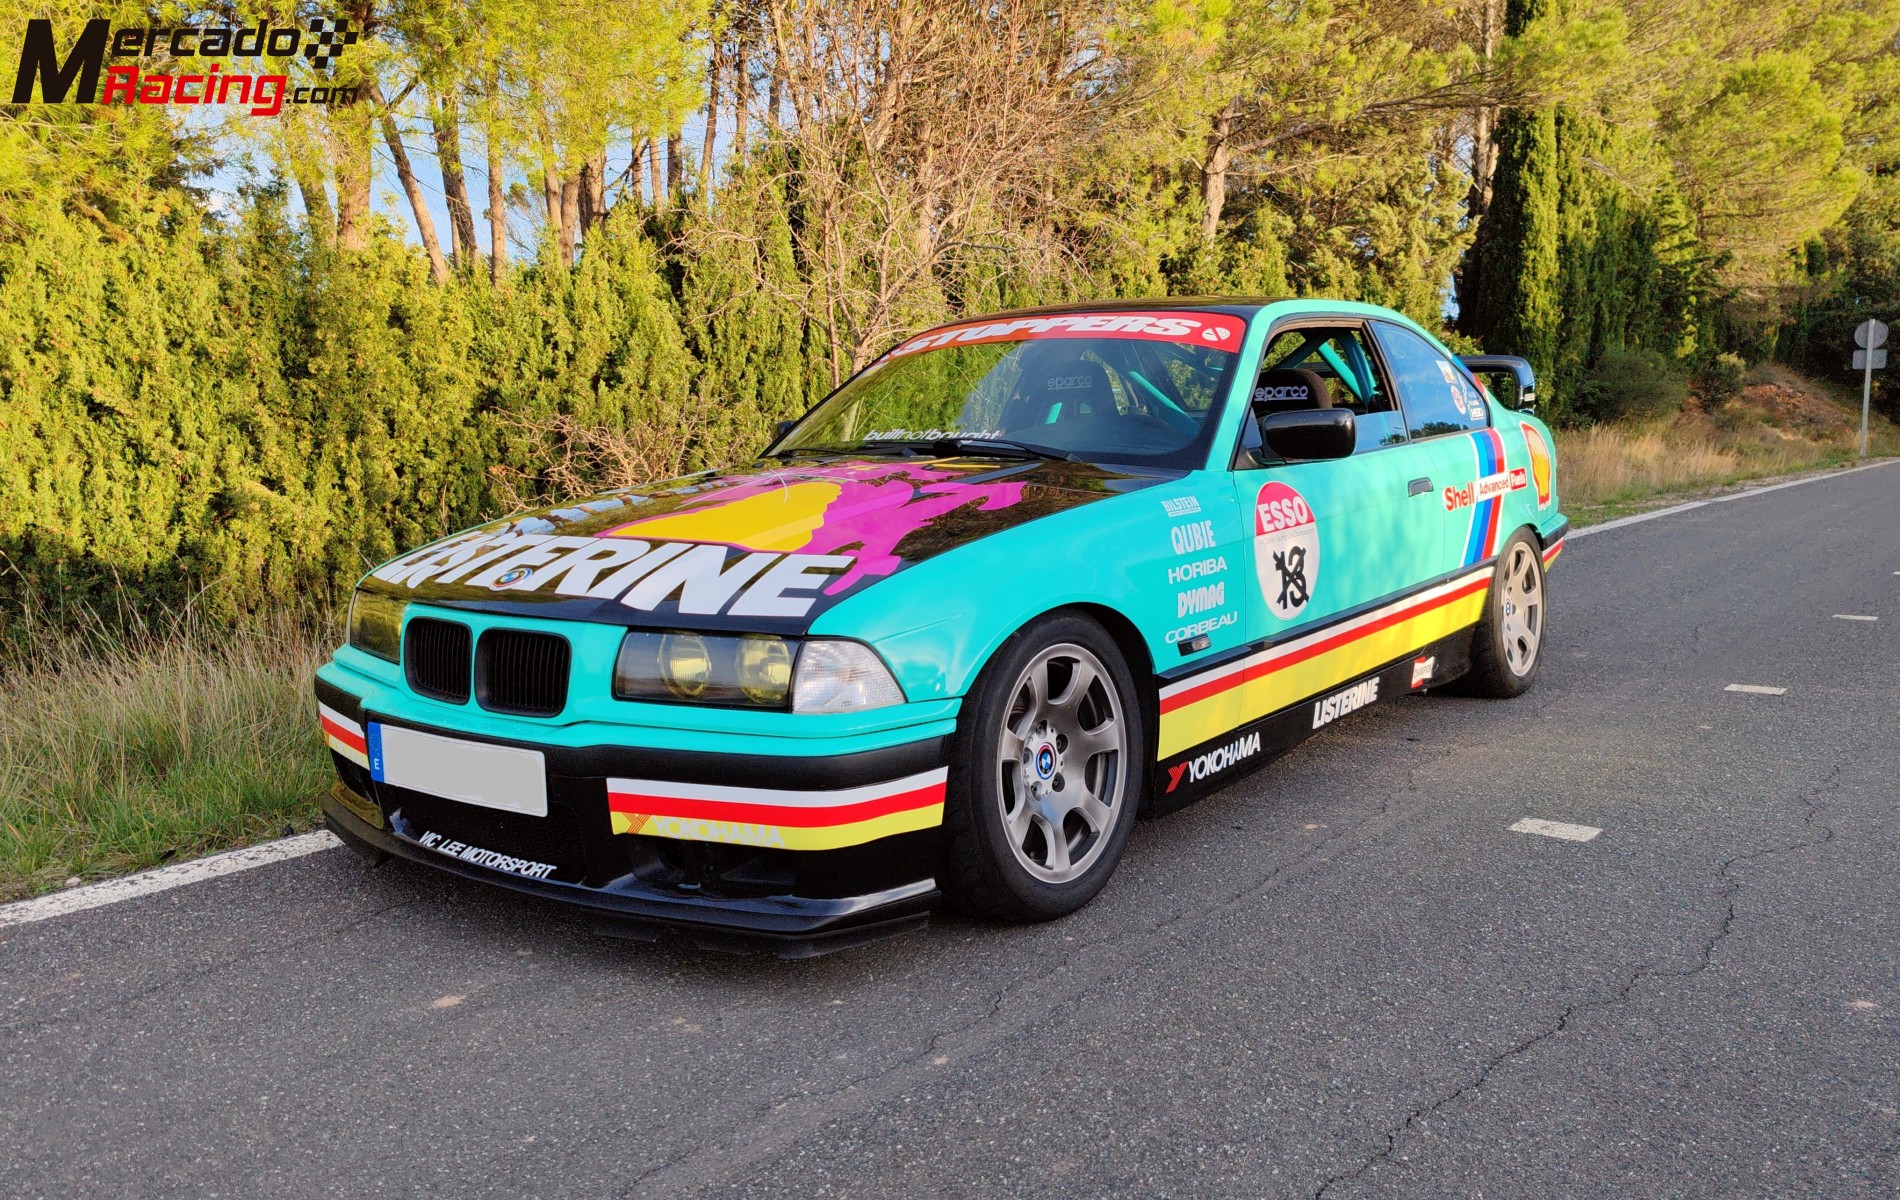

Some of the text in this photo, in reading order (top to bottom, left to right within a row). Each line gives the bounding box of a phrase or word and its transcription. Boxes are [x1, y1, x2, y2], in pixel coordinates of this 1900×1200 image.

[1161, 496, 1199, 511] BILSTEIN
[1445, 482, 1474, 511] Shell
[1479, 477, 1509, 496] Advanced
[1257, 496, 1309, 533] ESSO
[1171, 520, 1216, 555] QUBIE
[372, 531, 857, 616] LISTERINE
[1168, 556, 1227, 584] HORIBA
[1178, 582, 1225, 619] DYMAG
[1165, 611, 1238, 645] CORBEAU
[1313, 677, 1380, 730] LISTERINE
[374, 758, 380, 770] E
[1188, 732, 1261, 783] YOKOHAMA
[652, 816, 785, 849] YOKOHAMA
[419, 830, 557, 879] VIC LEE MOTORSPORT
